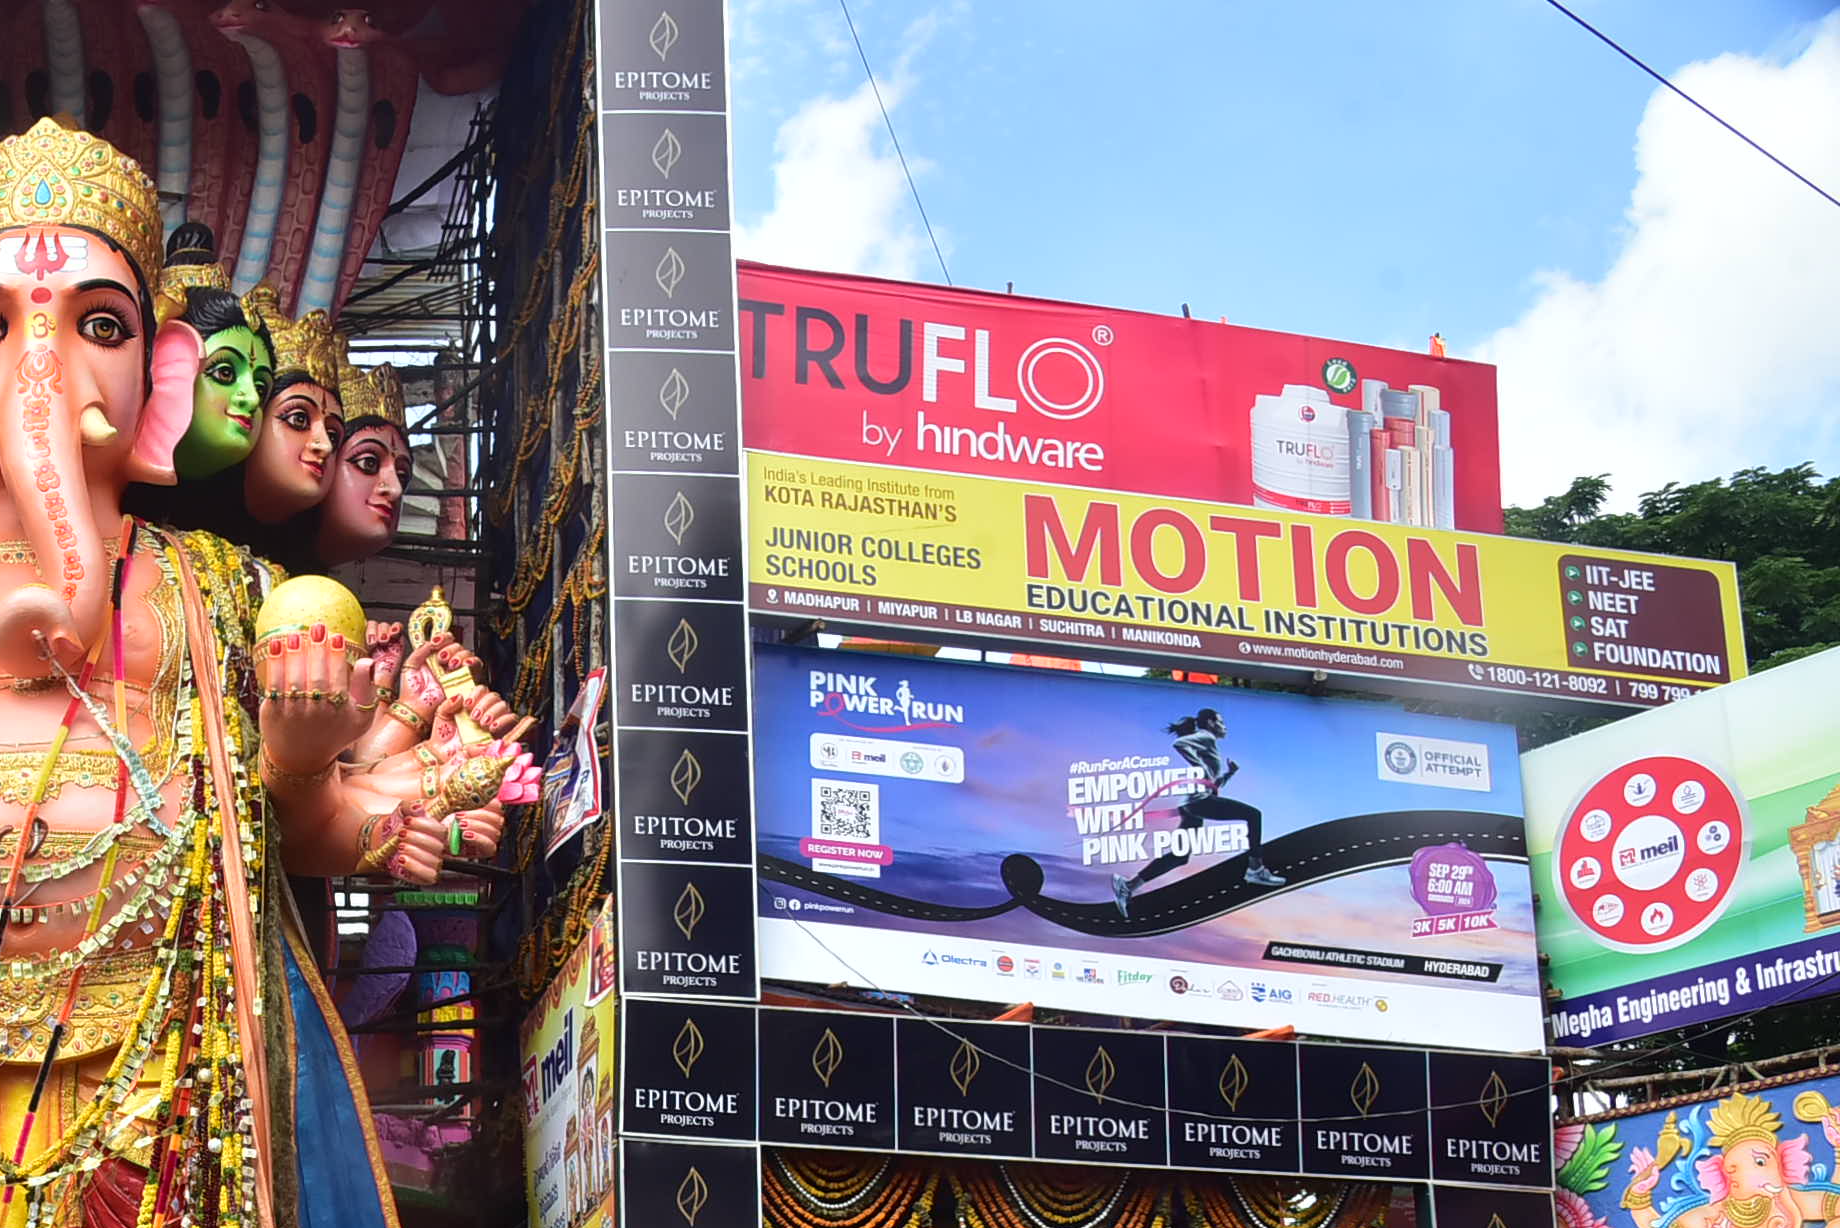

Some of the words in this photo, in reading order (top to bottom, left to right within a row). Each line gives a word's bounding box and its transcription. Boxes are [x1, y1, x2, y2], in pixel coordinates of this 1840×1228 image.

[617, 189, 715, 208] EPITOME
[642, 209, 694, 219] PROJECTS
[737, 299, 1104, 420] TRUFLO
[862, 410, 902, 457] by
[917, 411, 1104, 472] hindware
[763, 466, 807, 485] India's
[811, 470, 863, 492] Leading
[867, 476, 920, 497] Institute
[924, 483, 955, 501] from
[764, 485, 815, 507] KOTA
[820, 491, 957, 523] RAJASTHAN'S
[765, 527, 853, 555] JUNIOR
[862, 536, 982, 570] COLLEGES
[1024, 494, 1485, 628] MOTION
[766, 555, 877, 586] SCHOOLS
[1585, 564, 1656, 593] IIT-JEE
[784, 591, 860, 612] MADHAPUR
[878, 600, 938, 620] MIYAPUR
[1587, 590, 1638, 615] NEET
[956, 608, 973, 624] LB
[976, 610, 1022, 629] NAGAR
[1026, 583, 1253, 630] EDUCATIONAL
[1264, 611, 1489, 657] INSTITUTIONS
[1040, 618, 1104, 639] SUCHITRA
[1590, 616, 1630, 640] SAT
[1122, 627, 1201, 649] MANIKONDA
[1252, 642, 1404, 670] www.motionhyderabad.com
[1593, 642, 1722, 676] FOUNDATION
[810, 670, 877, 697] PINK
[1487, 666, 1607, 695] 1800-121-8092
[1629, 681, 1659, 699] 799
[810, 690, 895, 716] POWER
[912, 701, 964, 724] RUN
[1069, 753, 1170, 774] #RunForACause
[1424, 750, 1481, 767] OFFICIAL
[1424, 763, 1482, 779] ATTEMPT
[1067, 766, 1208, 806] EMPOWER
[634, 815, 737, 839] EPITOME
[1074, 801, 1145, 837] WITH
[659, 839, 715, 851] PROJECTS
[808, 843, 855, 858] REGISTER
[857, 847, 884, 860] NOW
[1082, 832, 1149, 866] PINK
[1153, 822, 1250, 860] POWER
[1640, 834, 1680, 861] meil
[1428, 863, 1450, 878] SEP
[1427, 878, 1452, 894] 6:00
[1453, 881, 1473, 896] AM
[1413, 920, 1431, 934] 3K
[1437, 917, 1456, 931] 5K
[1463, 914, 1489, 929] 10K
[1366, 955, 1405, 969] STADIUM
[1424, 960, 1490, 978] HYDERABAD
[1269, 988, 1293, 1001] AIG
[1553, 1004, 1614, 1040] Megha
[1617, 976, 1730, 1026] Engineering
[1735, 967, 1752, 995] &
[540, 1006, 574, 1105] meil
[1050, 1114, 1149, 1140] EPITOME
[1074, 1140, 1128, 1152] PROJECTS
